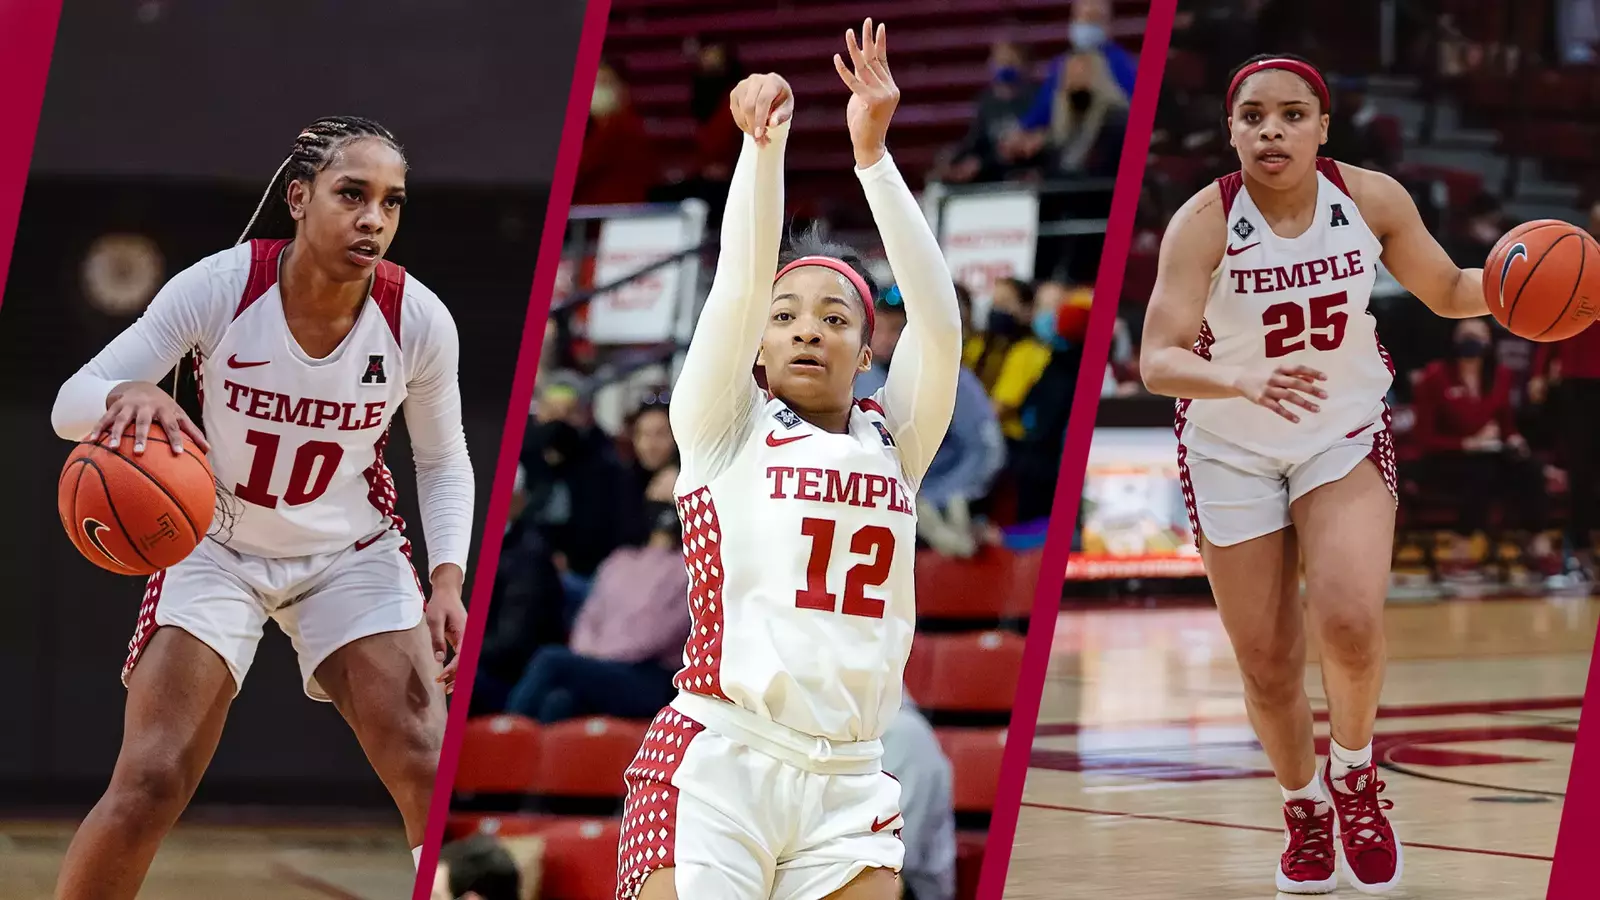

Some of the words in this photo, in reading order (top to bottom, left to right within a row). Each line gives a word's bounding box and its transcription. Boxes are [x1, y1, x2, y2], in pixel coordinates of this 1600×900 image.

[1230, 249, 1365, 294] TEMPLE
[1261, 290, 1349, 359] 25
[361, 354, 388, 385] A
[223, 379, 387, 431] TEMPLE
[234, 428, 345, 510] 10
[795, 516, 896, 619] 12
